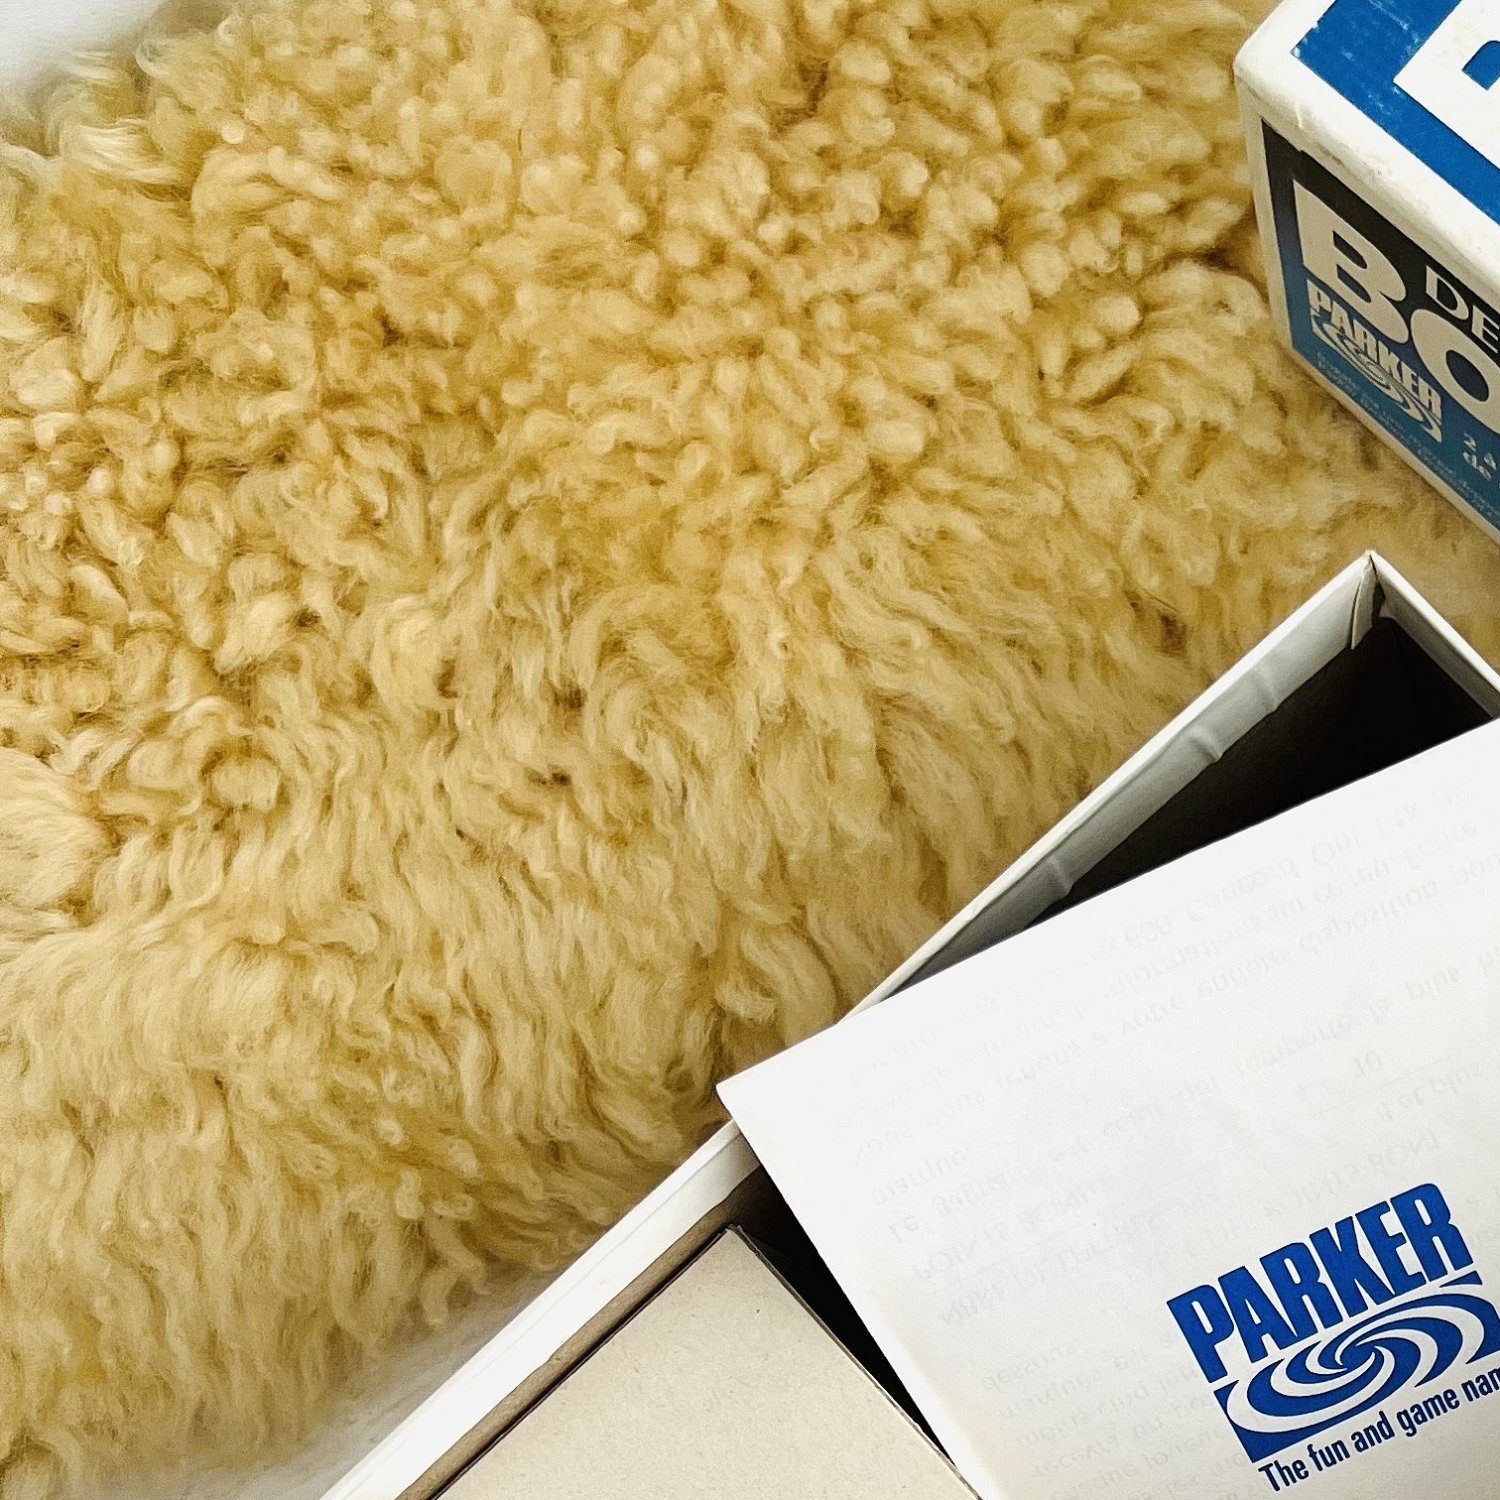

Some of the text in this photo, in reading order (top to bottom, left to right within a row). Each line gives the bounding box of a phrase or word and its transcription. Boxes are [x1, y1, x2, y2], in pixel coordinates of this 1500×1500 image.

[1306, 278, 1443, 427] PARKER
[1426, 265, 1500, 353] DE
[1462, 451, 1492, 482] de
[1166, 1182, 1474, 1384] PARKER
[1257, 1456, 1310, 1492] The
[1307, 1438, 1351, 1472] fun
[1350, 1410, 1395, 1454] and
[1396, 1386, 1460, 1438] game
